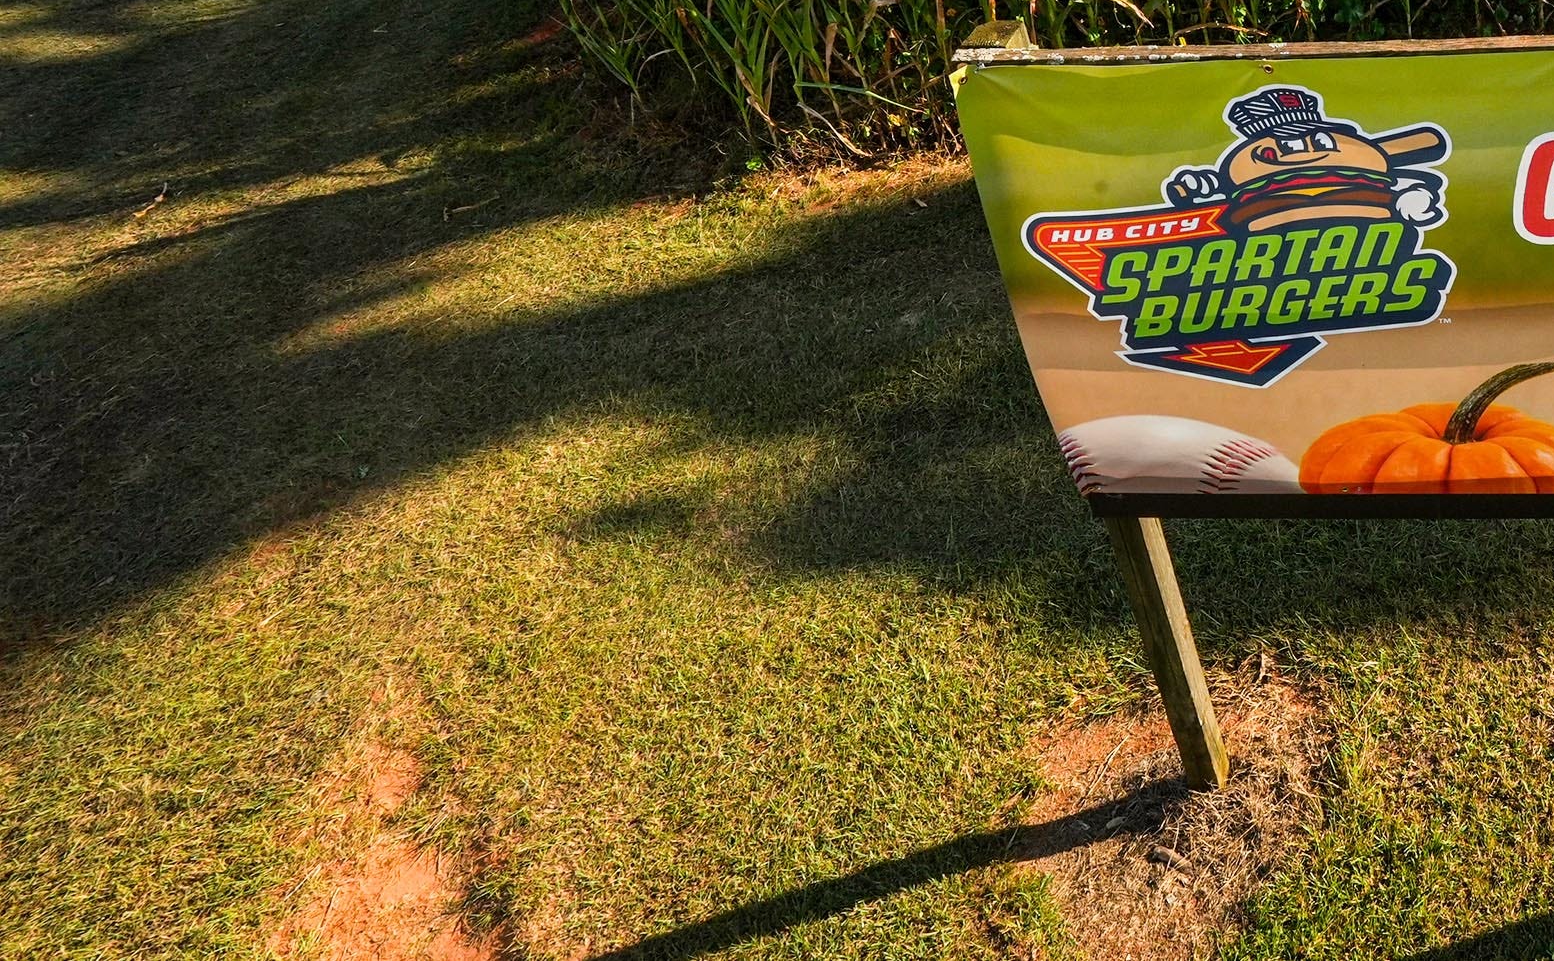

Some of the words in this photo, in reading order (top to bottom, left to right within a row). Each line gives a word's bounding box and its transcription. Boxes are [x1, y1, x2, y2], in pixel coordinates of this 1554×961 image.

[1050, 227, 1115, 243] HUB
[1125, 217, 1200, 239] CITY
[1101, 222, 1405, 304] SPARTAN
[1134, 258, 1438, 338] BURGERS
